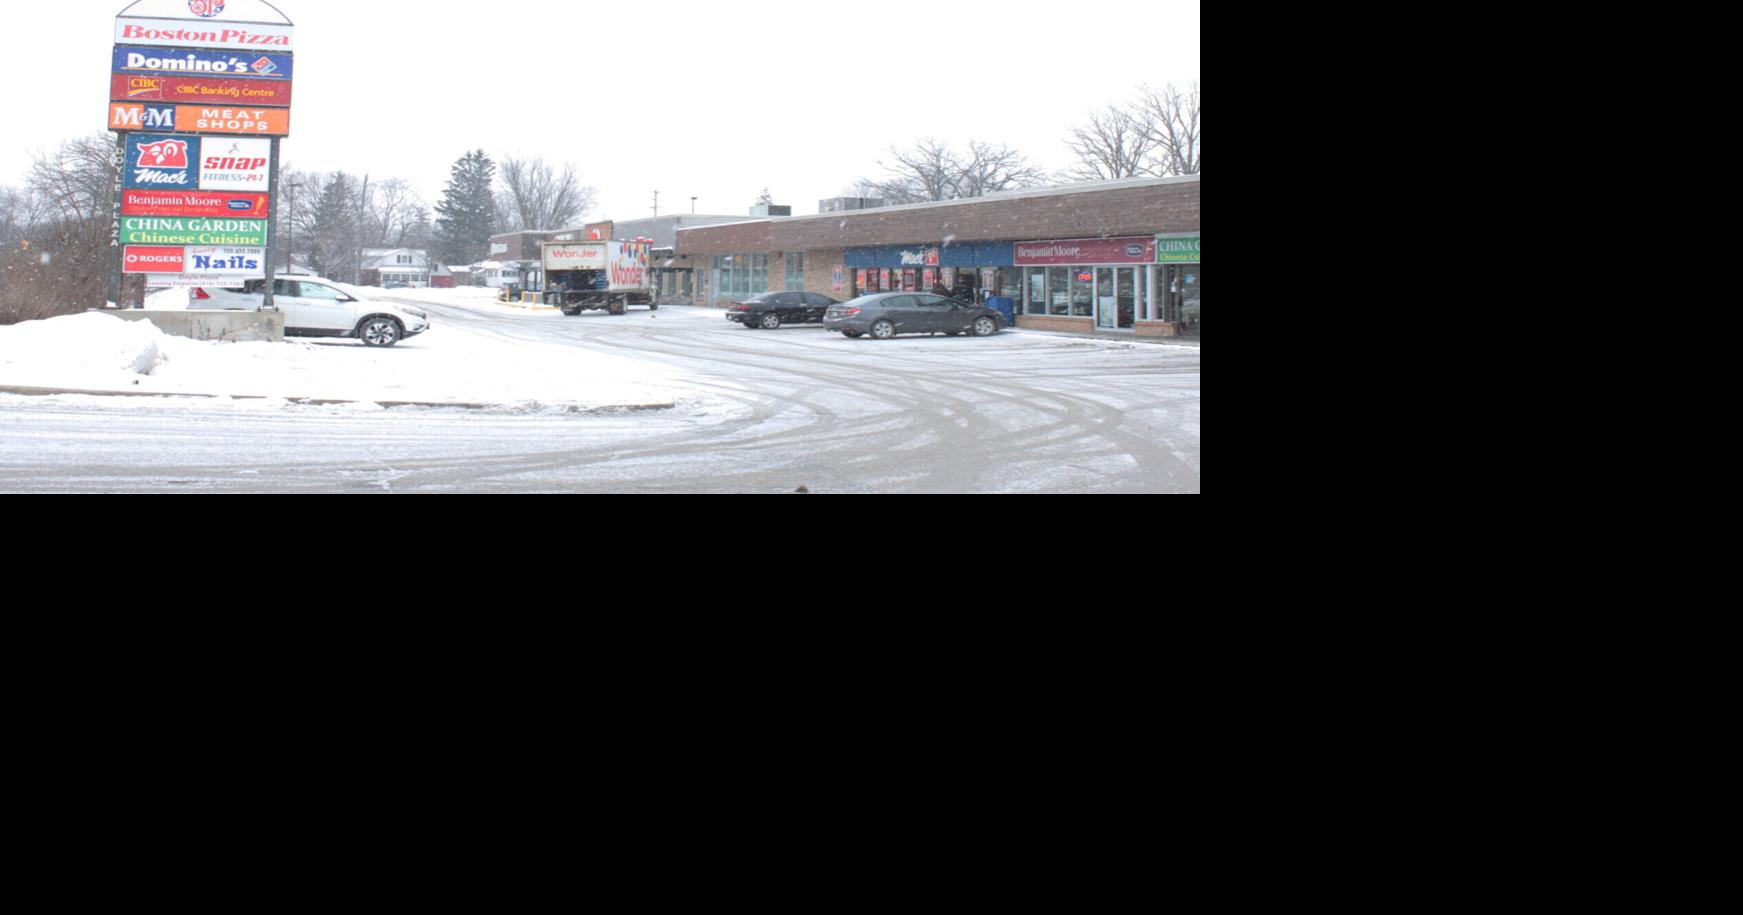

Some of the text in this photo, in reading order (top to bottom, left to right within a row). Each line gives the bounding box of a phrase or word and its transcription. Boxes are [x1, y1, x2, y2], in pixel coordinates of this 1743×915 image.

[122, 24, 289, 46] Boston Pizza
[127, 52, 248, 73] Domino's
[130, 78, 160, 89] CIBC
[176, 86, 275, 97] CIBC Banking Centre
[112, 106, 174, 127] M&M
[201, 108, 266, 120] MEAT
[196, 119, 269, 131] SHOPS
[115, 147, 125, 192] DOYLE
[133, 168, 189, 185] Mac's
[128, 195, 183, 207] Benjamin
[184, 196, 222, 207] Moore
[109, 202, 121, 247] PLAZA
[125, 218, 262, 233] CHINA GARDEN
[129, 231, 260, 245] Chinese Cuisine
[1018, 246, 1081, 257] Benjamin Moore
[1160, 241, 1193, 252] CHINA
[139, 255, 183, 263] ROGERS
[192, 255, 258, 271] Nails
[611, 260, 642, 286] Wonder
